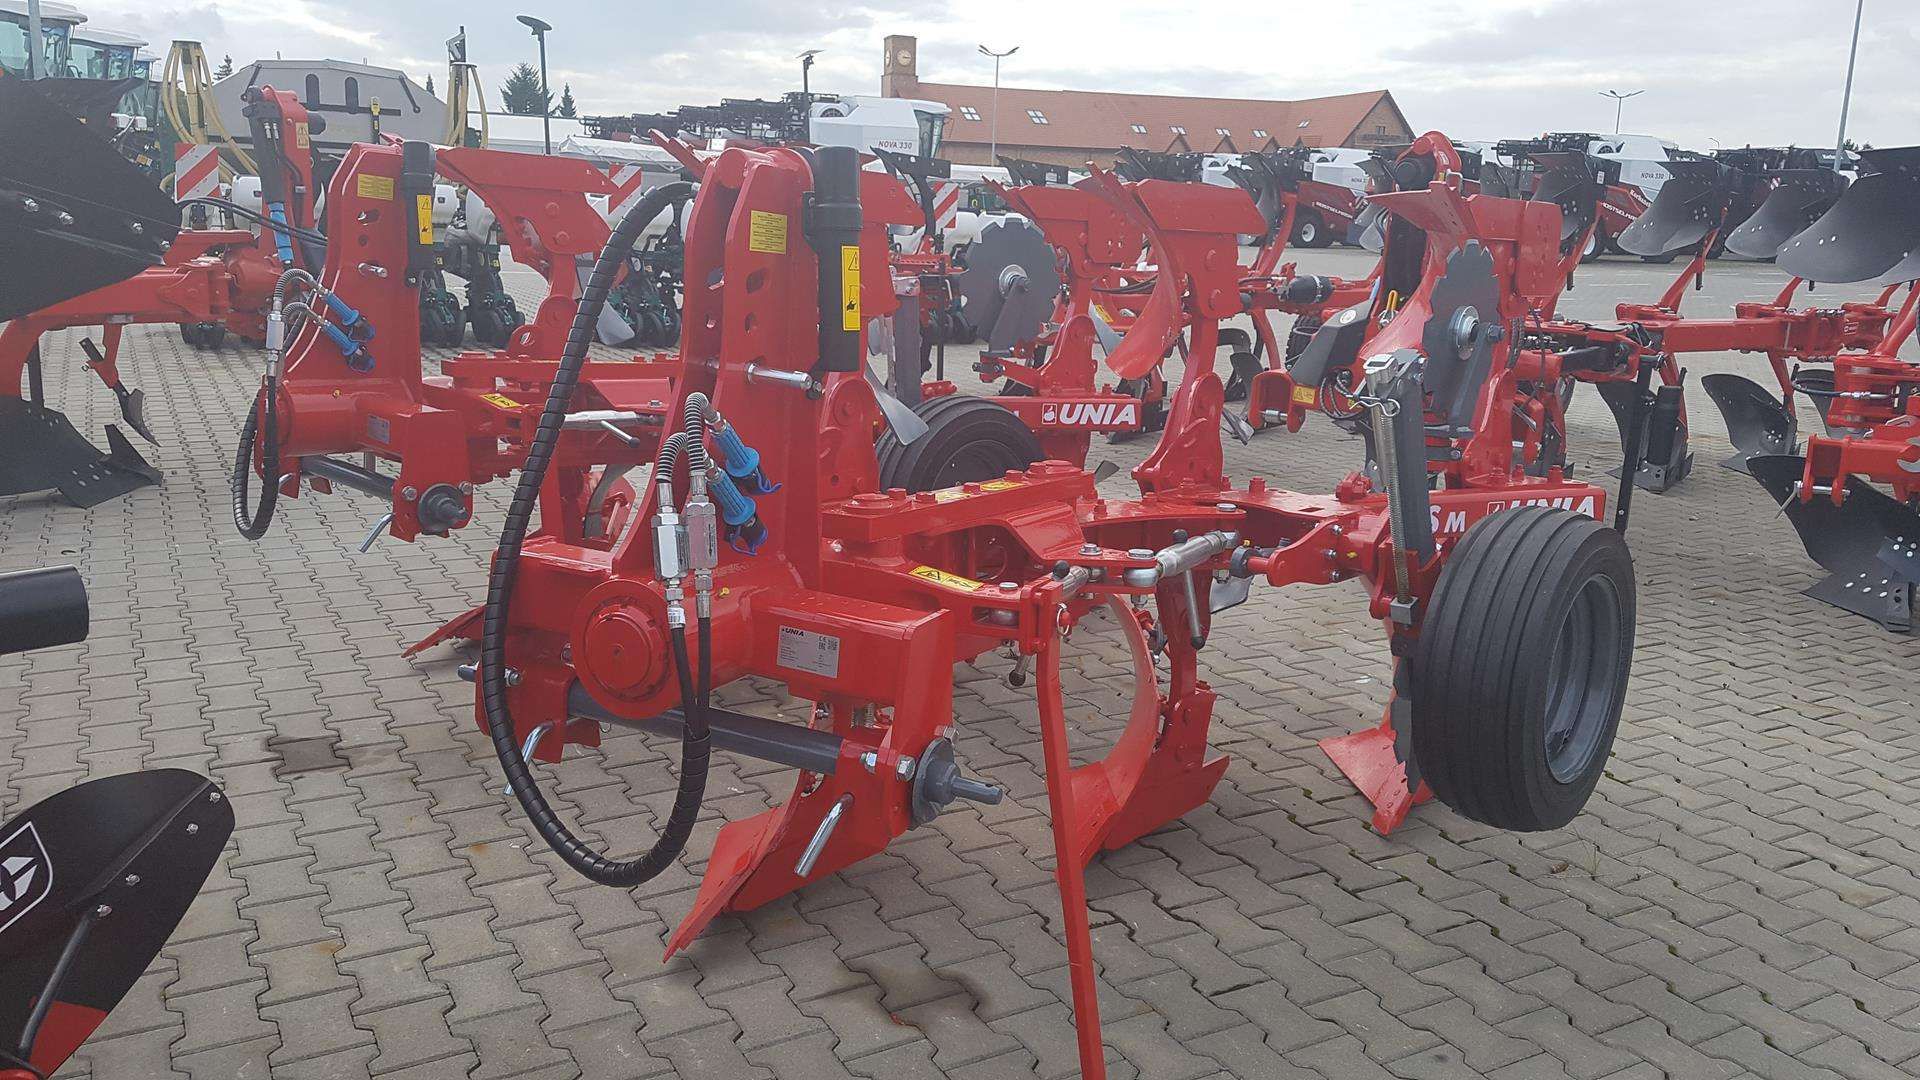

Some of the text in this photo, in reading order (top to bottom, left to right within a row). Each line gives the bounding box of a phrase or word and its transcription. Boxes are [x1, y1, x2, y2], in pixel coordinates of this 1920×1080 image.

[878, 141, 913, 150] NOVA 330
[1059, 403, 1137, 425] UNIA
[1443, 511, 1466, 533] M
[785, 628, 804, 636] UNIA
